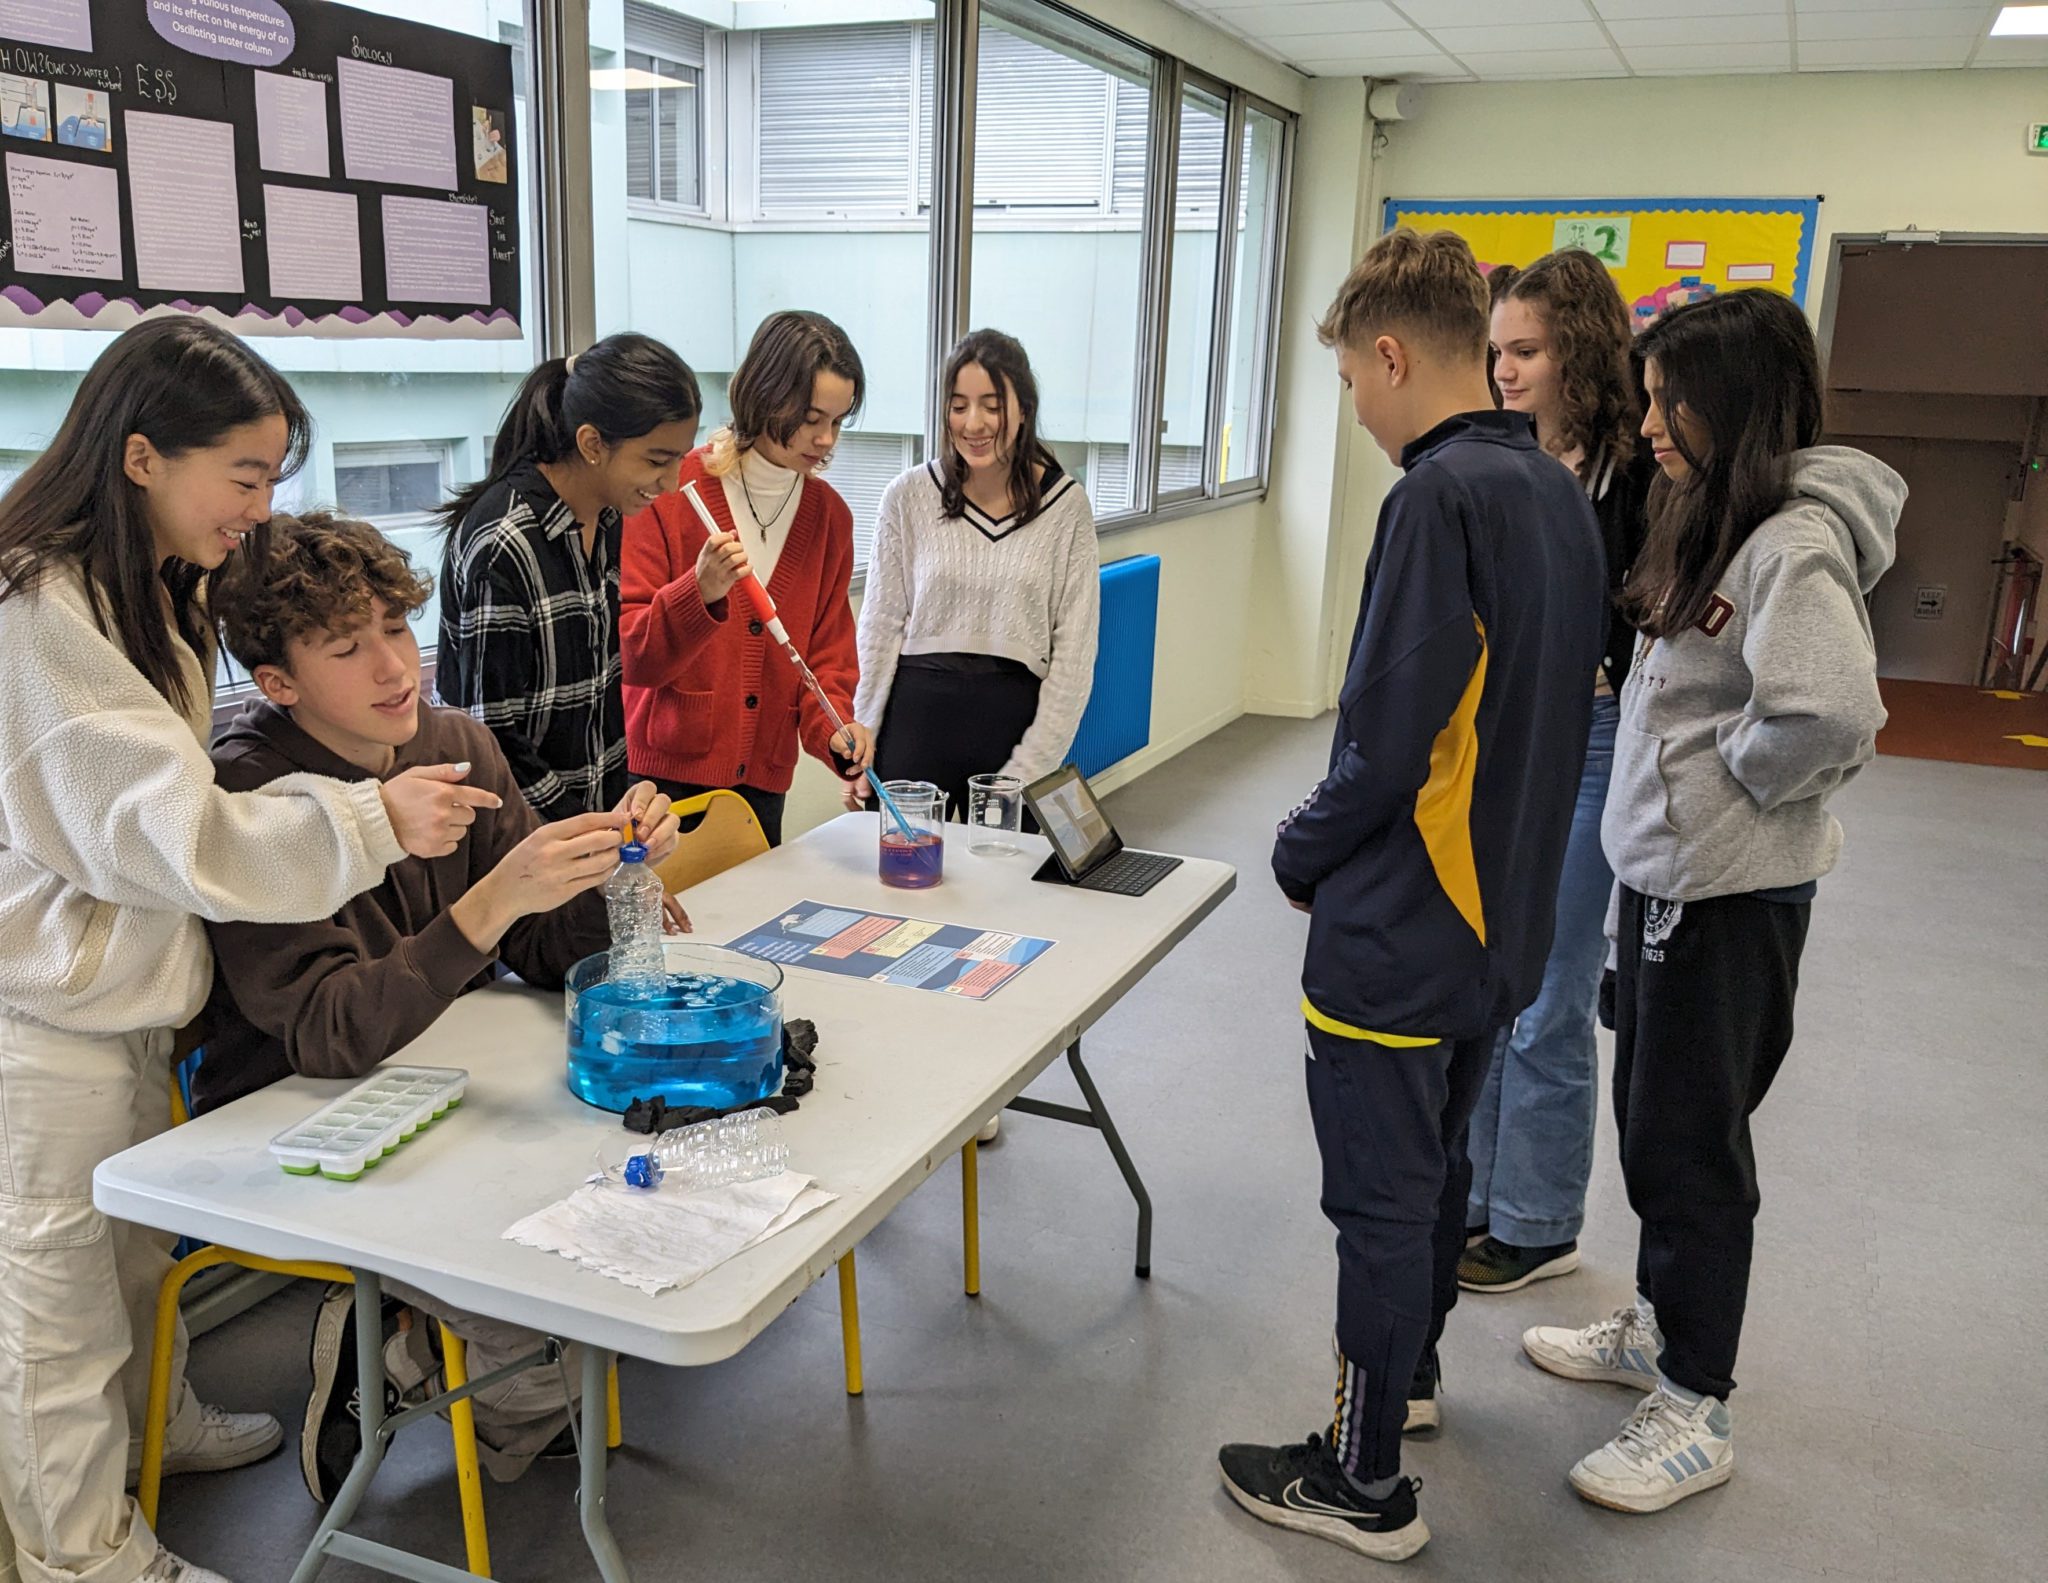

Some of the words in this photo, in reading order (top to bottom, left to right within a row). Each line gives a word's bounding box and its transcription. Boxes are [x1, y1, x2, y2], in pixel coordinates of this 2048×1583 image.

[153, 1, 171, 12] and
[172, 3, 183, 16] its
[185, 8, 210, 23] effect
[211, 16, 222, 26] on
[224, 18, 238, 31] the
[239, 24, 266, 40] energy
[267, 31, 277, 41] of
[278, 35, 289, 45] an
[230, 4, 285, 27] temperatures
[172, 21, 216, 43] Oscillating
[218, 35, 243, 49] water
[244, 41, 273, 56] column
